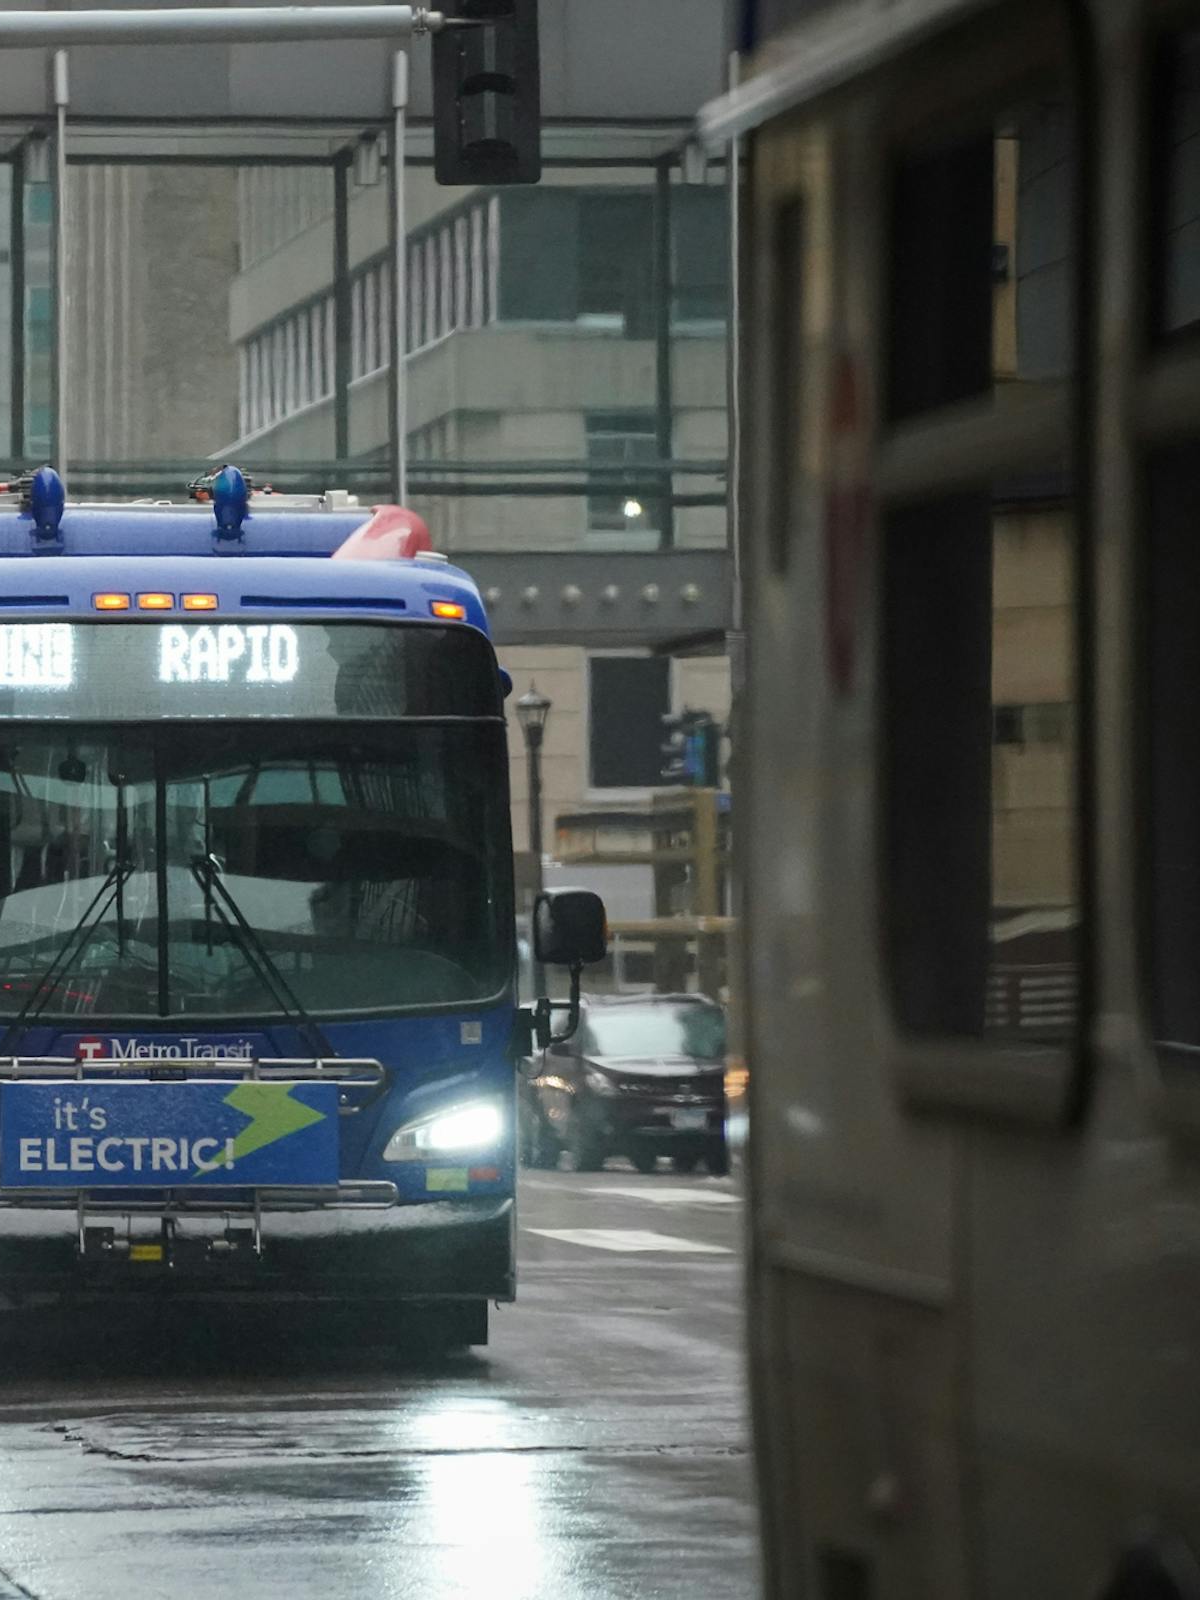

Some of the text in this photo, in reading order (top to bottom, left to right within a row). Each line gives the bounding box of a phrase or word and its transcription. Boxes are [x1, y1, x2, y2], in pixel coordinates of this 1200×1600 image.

[159, 624, 299, 682] RAPID
[54, 1097, 107, 1130] it's
[19, 1137, 235, 1171] ELECTRIC!
